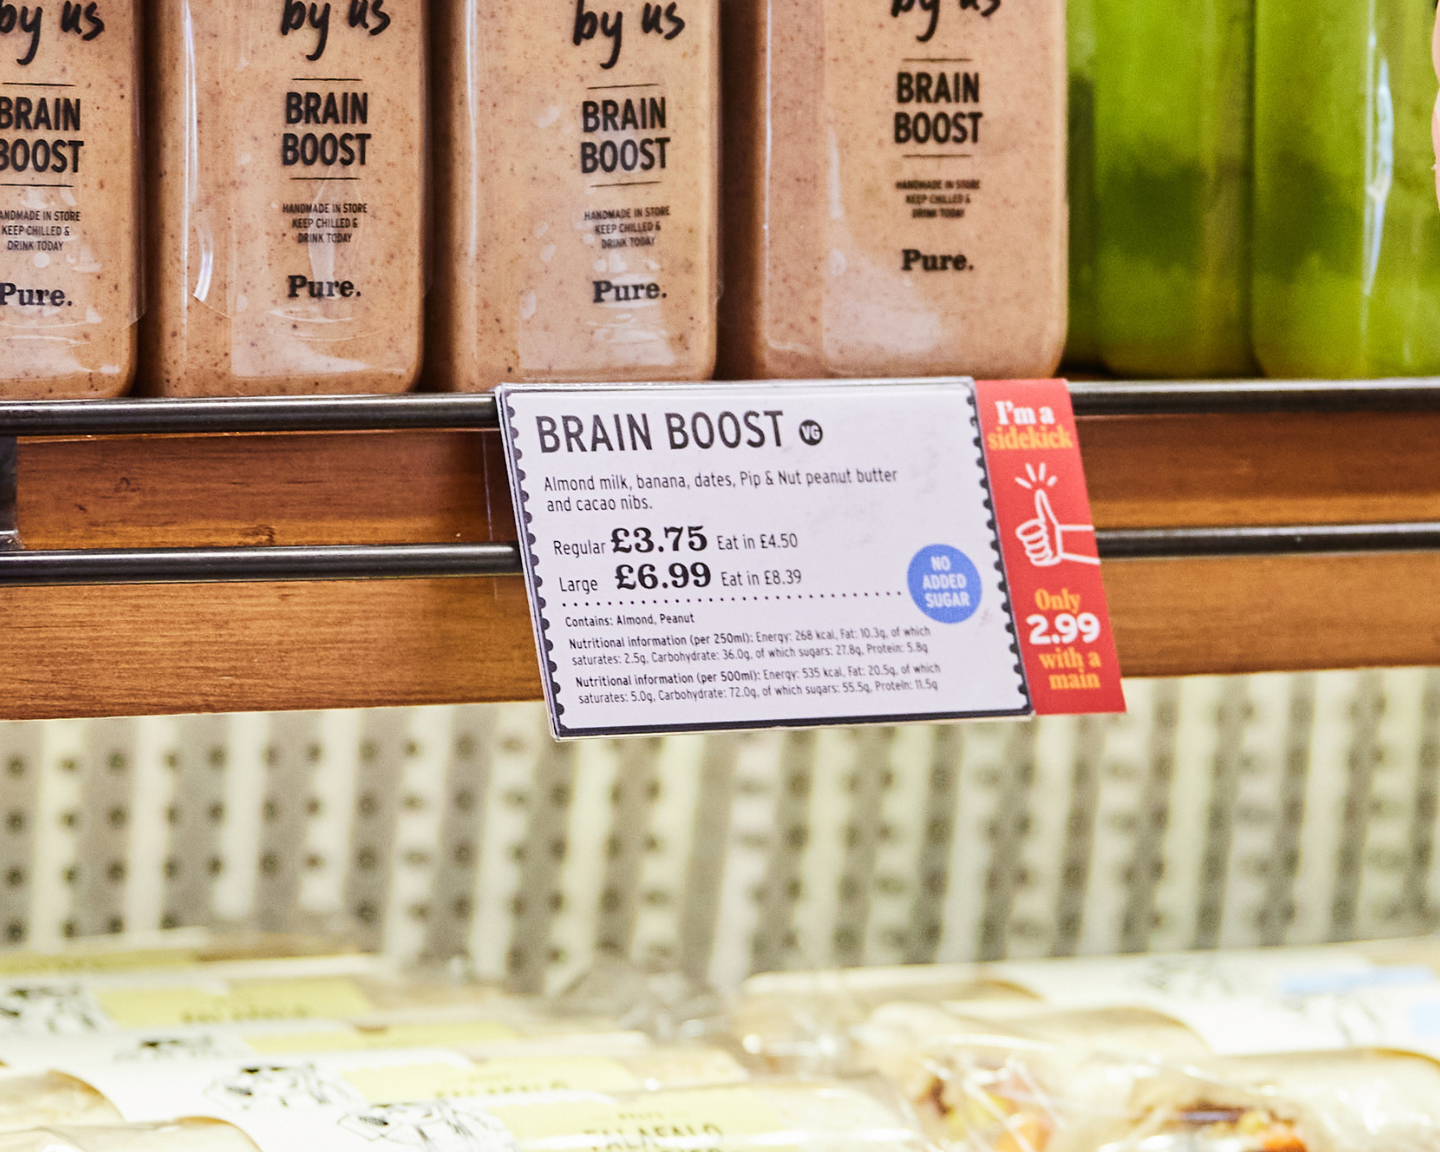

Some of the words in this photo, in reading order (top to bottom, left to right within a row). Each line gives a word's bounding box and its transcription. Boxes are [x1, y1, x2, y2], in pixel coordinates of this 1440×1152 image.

[61, 0, 105, 41] us
[642, 1, 686, 40] us
[896, 71, 980, 104] BRAIN
[0, 97, 81, 131] BRAIN
[285, 91, 368, 125] BRAIN
[581, 97, 667, 134] BRAIN
[894, 111, 983, 144] BOOST
[281, 133, 372, 167] BOOST
[581, 137, 670, 175] BOOST
[901, 248, 974, 272] Pure.
[0, 282, 73, 307] Pure.
[287, 275, 361, 298] Pure.
[592, 280, 667, 303] Pure.
[995, 400, 1037, 425] I'm
[1038, 406, 1055, 424] a
[535, 413, 653, 453] BRAIN
[664, 410, 784, 450] BOOST
[800, 422, 822, 443] VG
[987, 424, 1073, 451] sidekick
[544, 476, 595, 492] Almond
[600, 473, 632, 491] milk,
[637, 473, 690, 491] banana,
[695, 471, 737, 488] dates,
[740, 470, 761, 489] Pip
[765, 470, 774, 485] &
[779, 469, 802, 485] Nut
[806, 469, 852, 487] peanut
[856, 467, 898, 483] butter
[547, 497, 572, 512] and
[576, 498, 616, 511] cacao
[621, 494, 653, 510] nibs.
[553, 539, 606, 559] Regular
[610, 525, 708, 554] £3.75
[717, 535, 739, 550] Eat
[743, 533, 756, 549] in
[760, 532, 798, 549] £4.50
[930, 555, 949, 571] NO
[559, 576, 598, 594] Large
[615, 561, 711, 590] £6.99
[721, 571, 743, 587] Eat
[747, 570, 760, 586] in
[764, 568, 802, 585] £8.39
[922, 573, 968, 590] ADDED
[924, 591, 970, 608] SUGAR
[1034, 588, 1081, 614] Only
[565, 616, 614, 628] Contains:
[616, 614, 657, 626] Almond,
[660, 613, 695, 624] Peanut
[1026, 612, 1100, 645] 2.99
[569, 636, 625, 650] Nutritional
[628, 634, 687, 648] information
[690, 634, 710, 647] (per
[756, 631, 792, 645] Energy:
[795, 630, 813, 641] 268
[840, 628, 858, 639] Fat:
[892, 626, 900, 637] of
[903, 625, 931, 637] which
[572, 655, 622, 666] saturates:
[651, 650, 720, 664] Carbohydrate:
[756, 647, 764, 659] of
[768, 646, 796, 658] which
[799, 645, 833, 659] sugars:
[867, 642, 904, 654] Protein:
[907, 642, 928, 654] 5.8g
[1038, 646, 1084, 669] with
[1088, 651, 1101, 668] a
[1049, 669, 1100, 691] main
